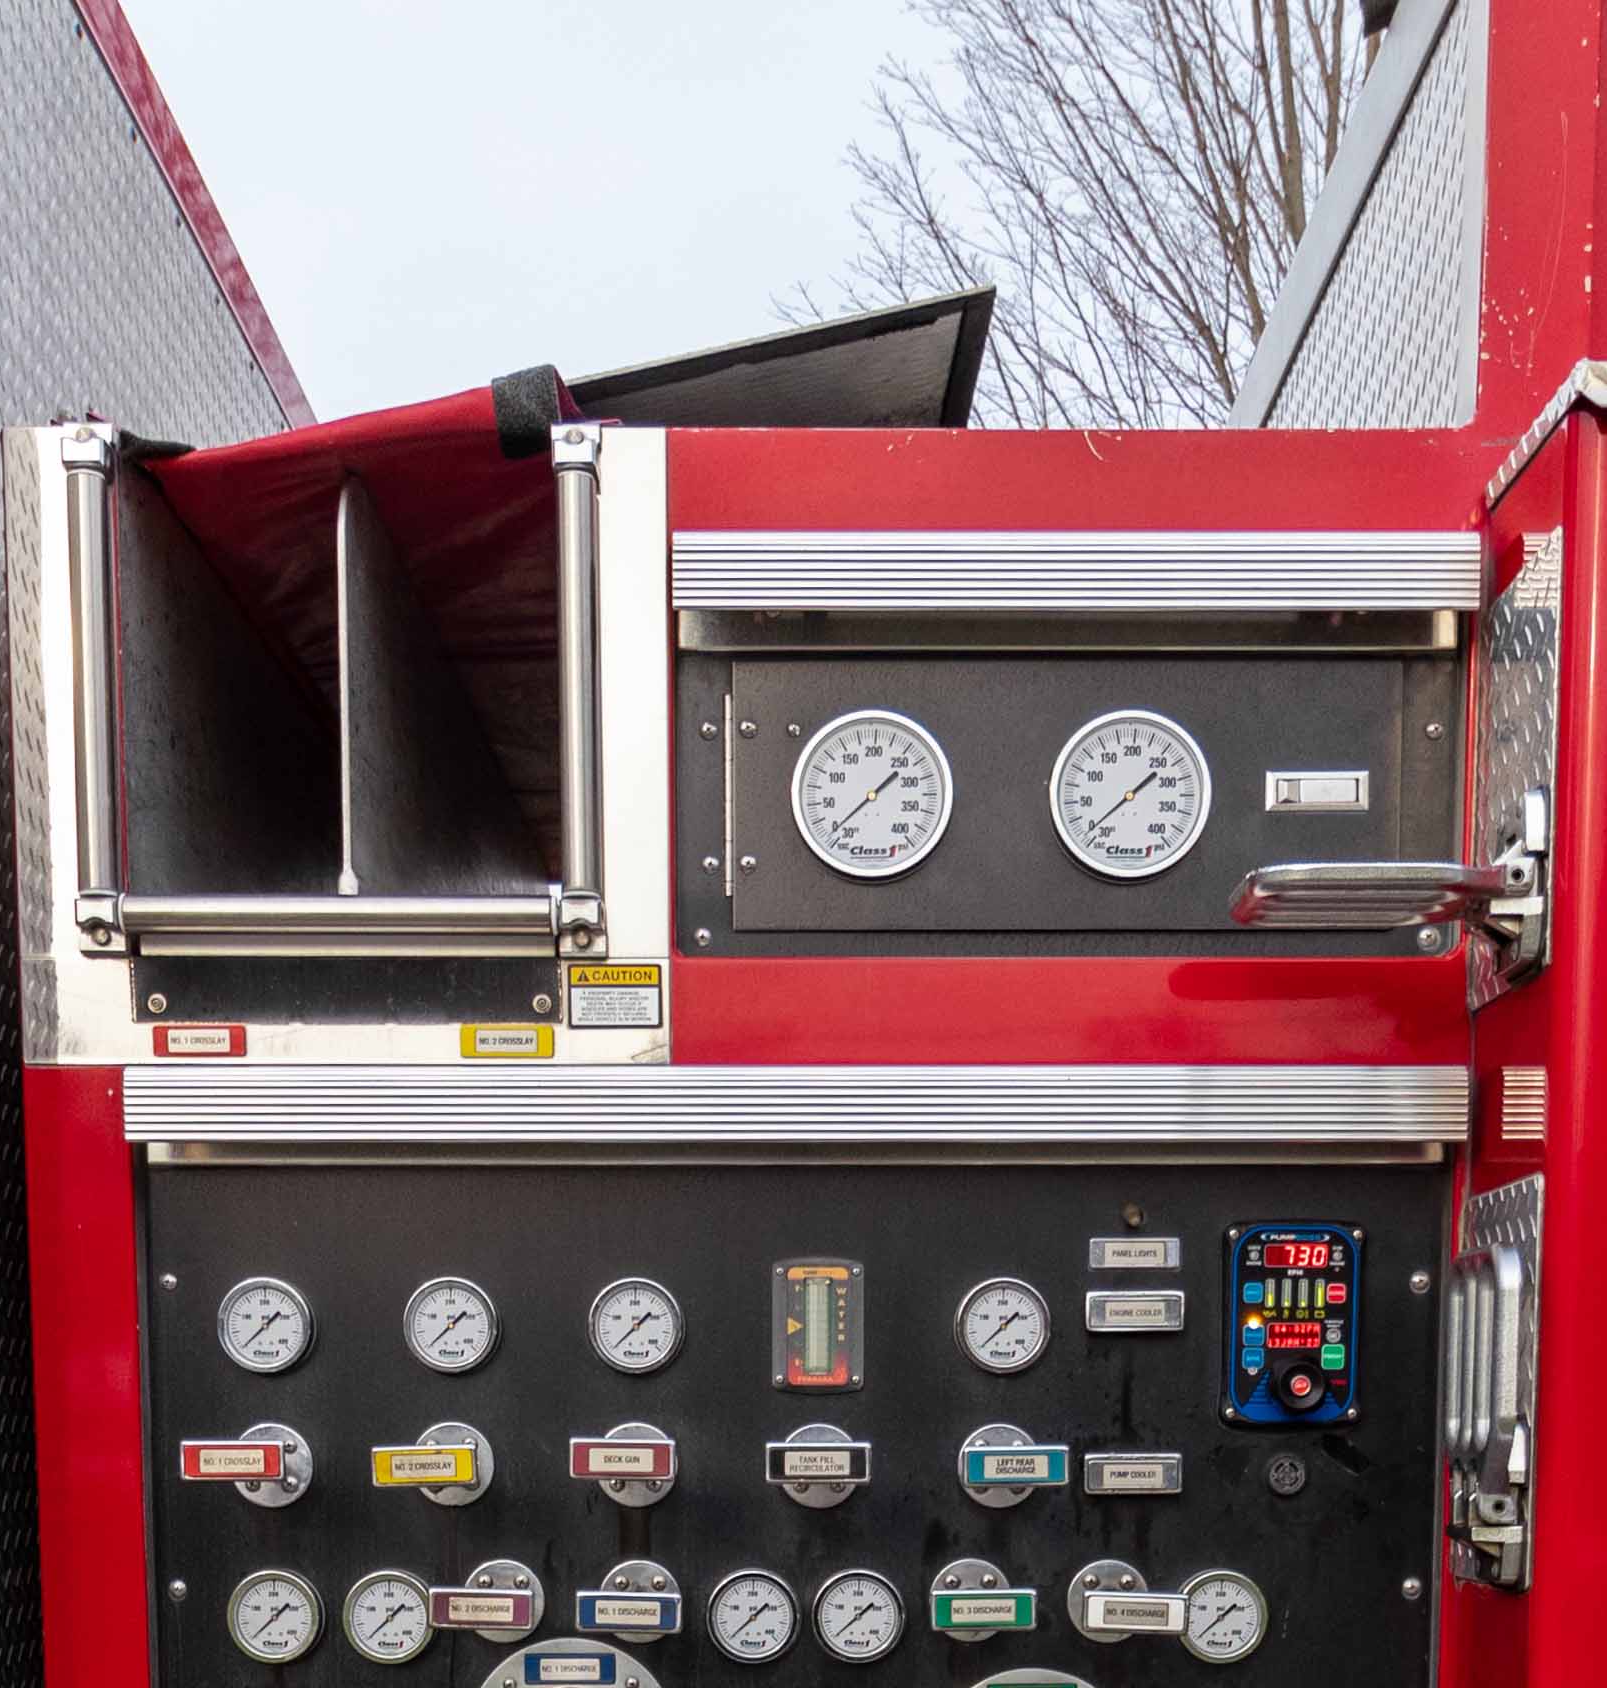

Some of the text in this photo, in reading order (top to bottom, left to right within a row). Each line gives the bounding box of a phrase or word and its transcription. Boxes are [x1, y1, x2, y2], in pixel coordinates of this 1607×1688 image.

[865, 746, 883, 757] 200
[1123, 746, 1141, 757] 200
[842, 754, 859, 764] 150
[890, 757, 908, 768] 250
[1101, 753, 1117, 764] 150
[1149, 758, 1167, 768] 250
[829, 772, 845, 783] 100
[1087, 771, 1103, 782] 100
[900, 777, 919, 787] 300
[1158, 777, 1176, 788] 300
[823, 797, 835, 808] 50
[901, 801, 919, 812] 350
[1080, 796, 1092, 807] 50
[1158, 802, 1176, 812] 350
[891, 823, 909, 834] 400
[1147, 824, 1166, 834] 400
[593, 971, 652, 981] CAUTION
[190, 1037, 226, 1045] CROSSLAY
[499, 1037, 534, 1045] CROSSLAY
[1285, 1246, 1326, 1266] 730
[836, 1288, 847, 1344] WATER
[225, 1457, 261, 1465] CROSSLAY
[799, 1456, 834, 1464] TANK FILL
[1016, 1458, 1035, 1466] REAR
[790, 1464, 844, 1472] RECIRCULATOR
[995, 1466, 1035, 1474] DISCHARGE
[598, 1607, 610, 1615] NO.
[618, 1608, 657, 1616] DISCHARGE
[1126, 1609, 1165, 1617] DISCHARGE
[560, 1665, 597, 1673] DISCHARGE
